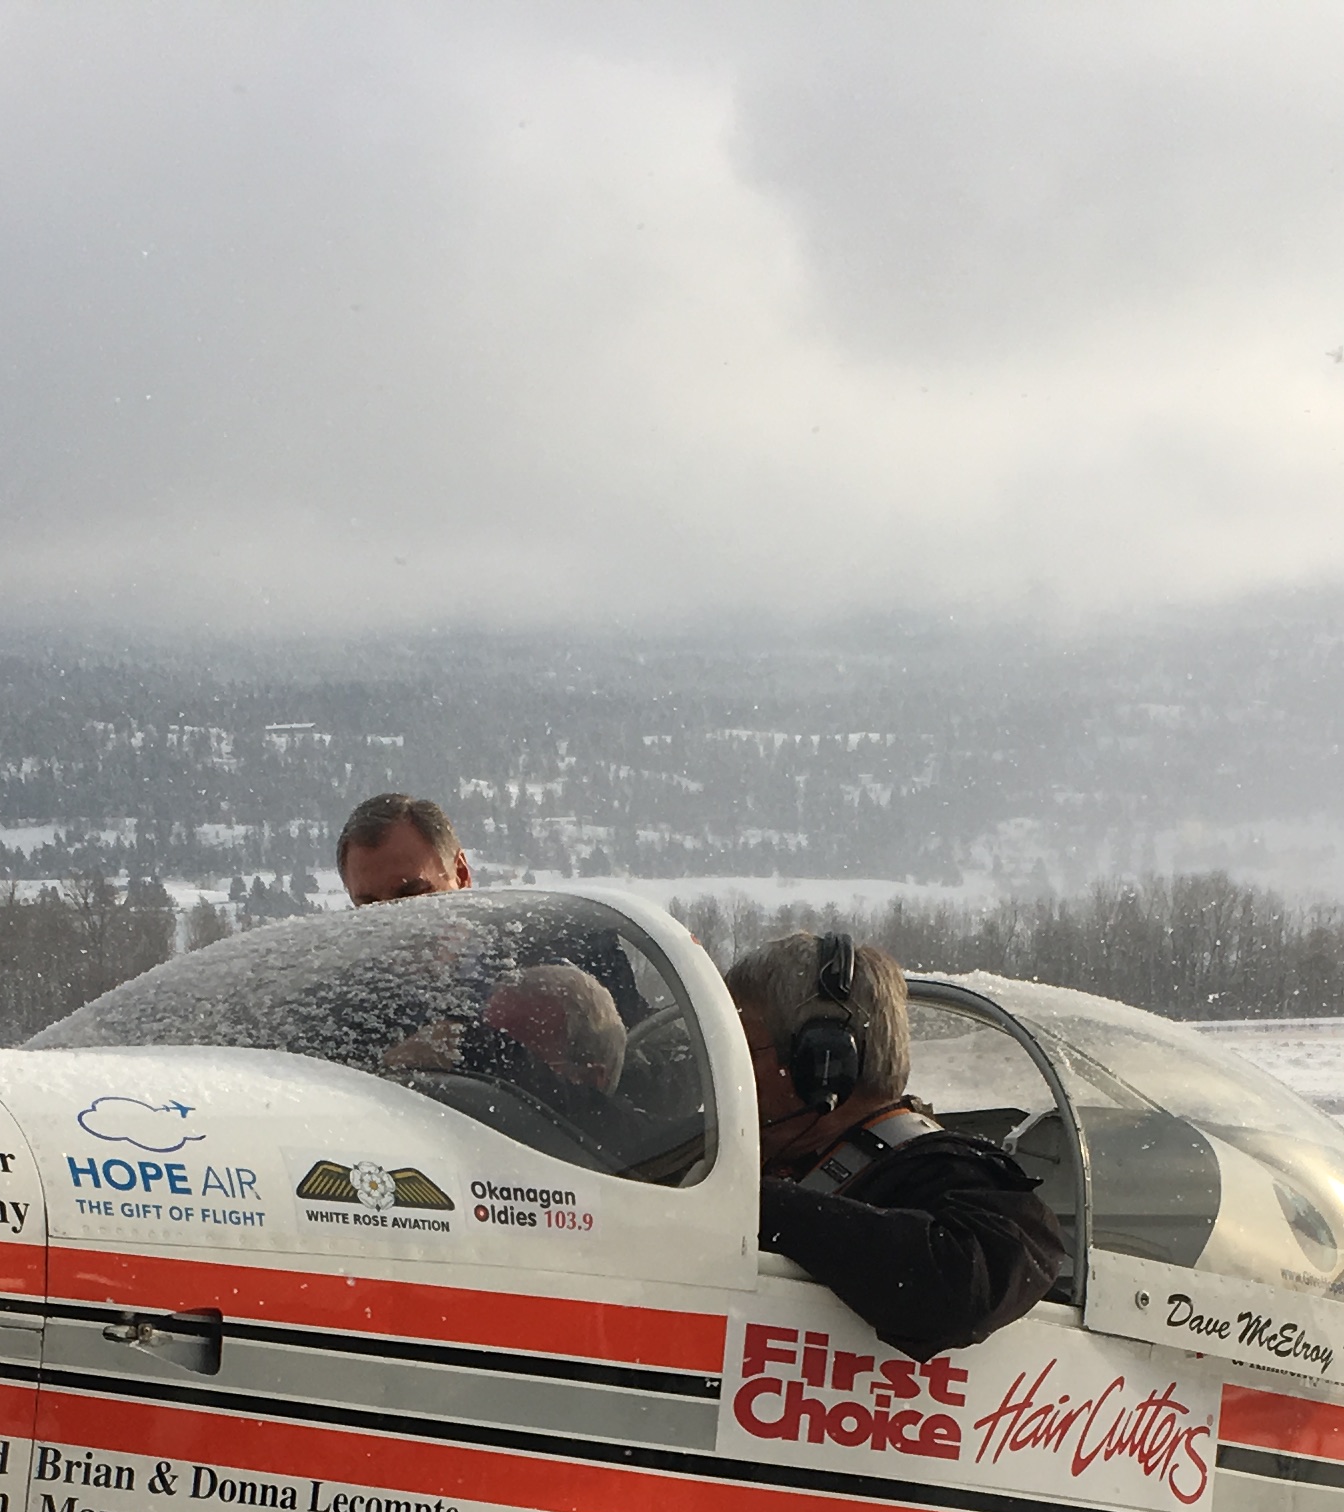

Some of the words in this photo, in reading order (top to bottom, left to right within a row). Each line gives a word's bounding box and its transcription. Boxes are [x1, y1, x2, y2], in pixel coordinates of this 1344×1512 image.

[67, 1156, 192, 1195] HOPE
[201, 1166, 261, 1200] AIR
[470, 1180, 577, 1207] Okanagan
[75, 1199, 115, 1218] THE
[120, 1203, 163, 1222] GIFT
[168, 1207, 195, 1224] OF
[200, 1209, 266, 1228] FLIGHT
[306, 1209, 350, 1227] WHITE
[352, 1213, 389, 1229] ROSE
[391, 1215, 451, 1233] AVIATION
[473, 1204, 538, 1228] Oldies
[544, 1211, 594, 1232] 103.9
[1165, 1293, 1233, 1341] Dave
[1236, 1311, 1333, 1374] McElroy
[741, 1323, 968, 1408] First
[733, 1377, 962, 1461] Choice
[34, 1445, 135, 1491] Brian
[147, 1460, 180, 1496] &
[190, 1465, 297, 1510] Donna
